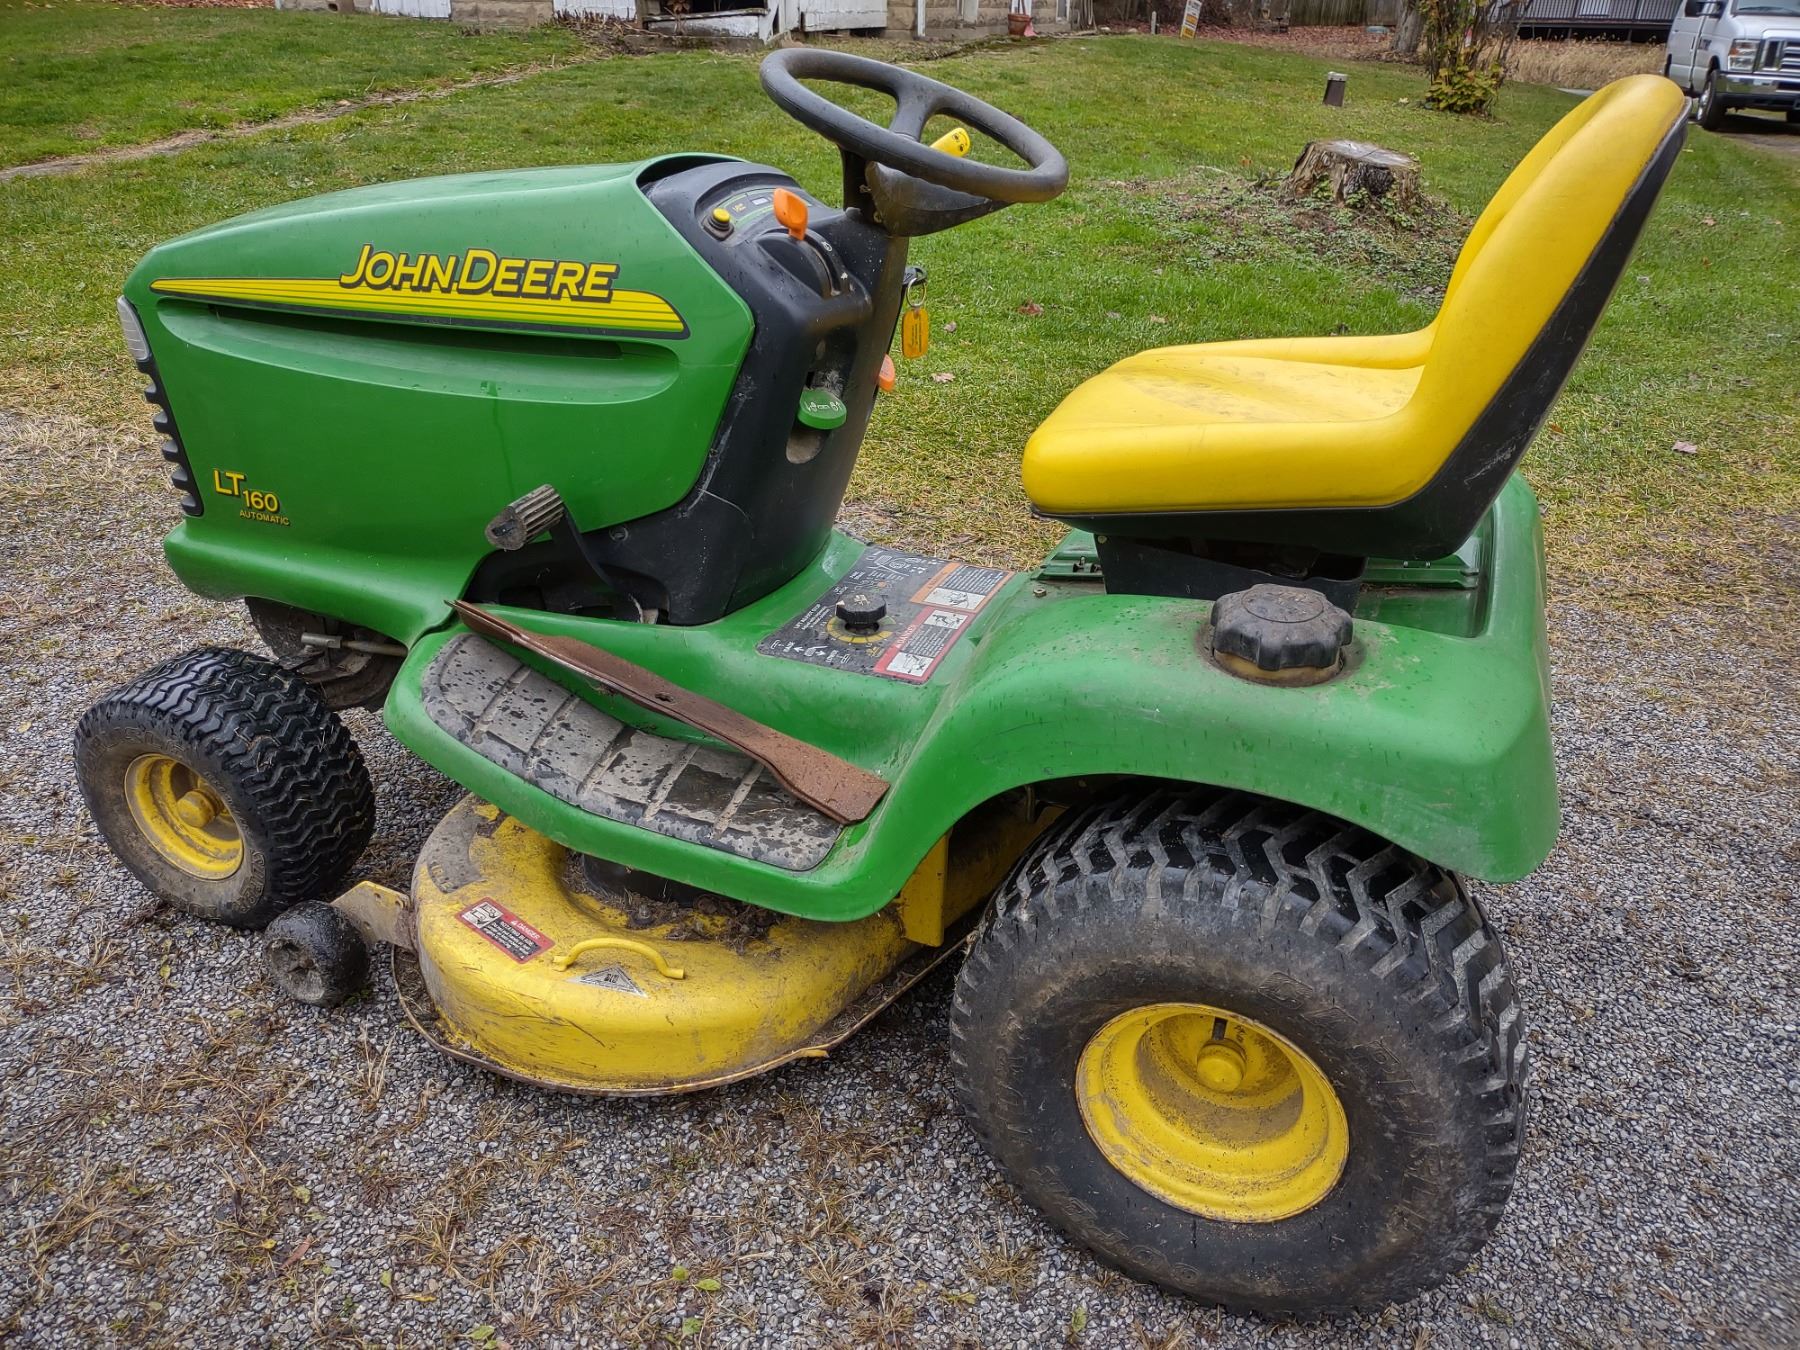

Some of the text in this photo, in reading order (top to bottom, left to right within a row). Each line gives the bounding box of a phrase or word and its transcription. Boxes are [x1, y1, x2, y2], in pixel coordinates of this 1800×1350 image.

[340, 243, 620, 304] JOHN DEERE
[213, 469, 246, 497] LT
[242, 489, 280, 514] 160
[240, 510, 290, 526] AUTOMATIC
[516, 922, 541, 940] DANGER
